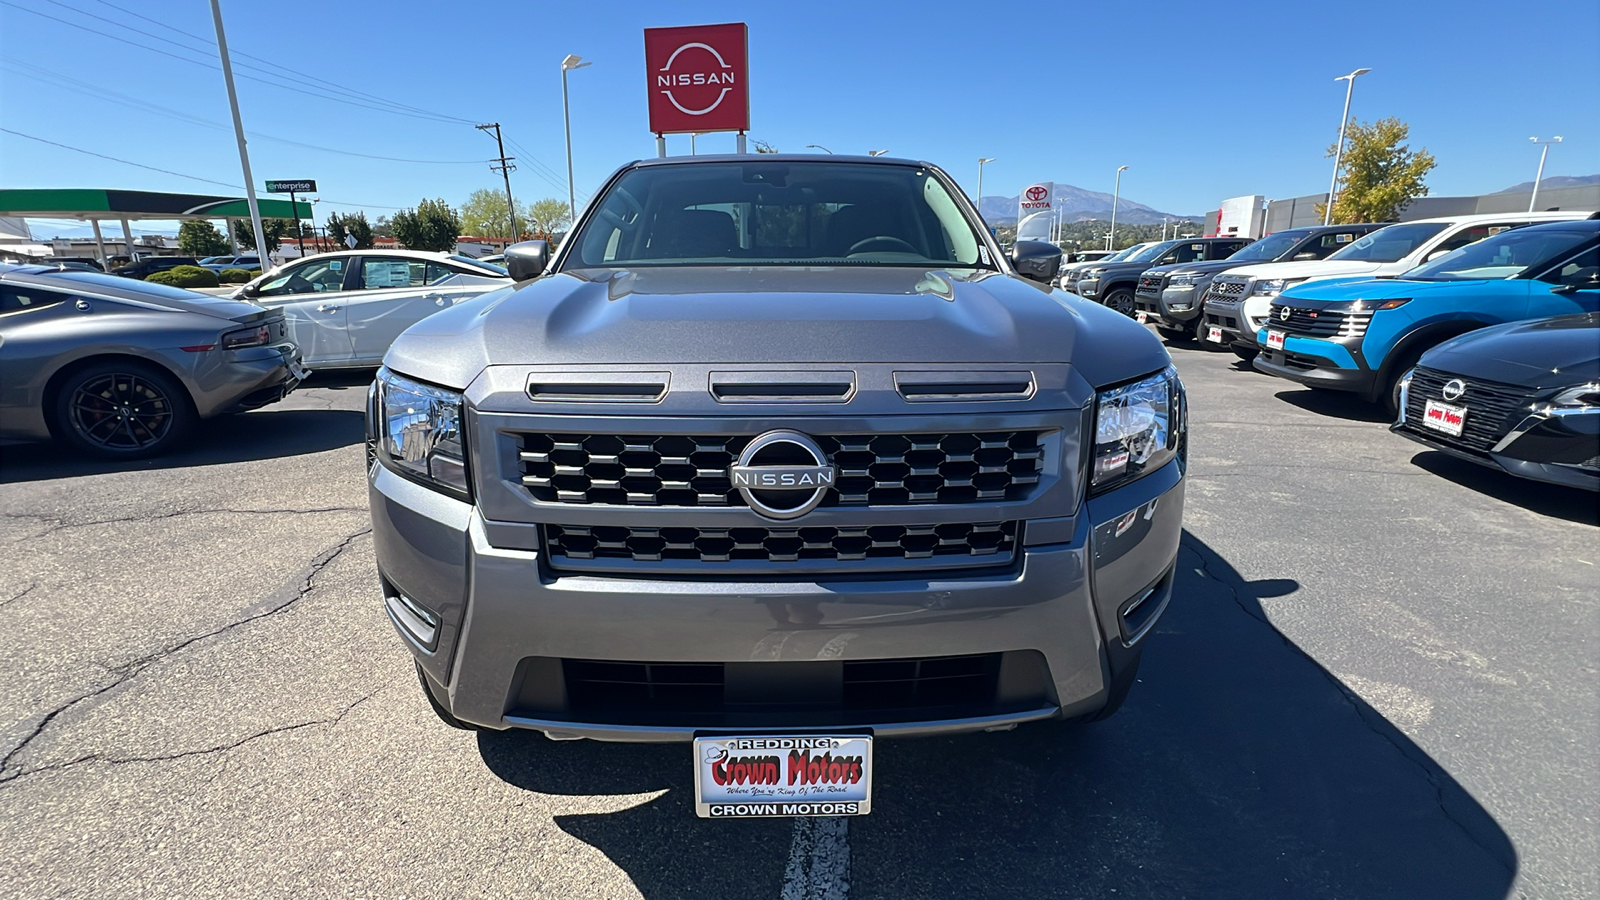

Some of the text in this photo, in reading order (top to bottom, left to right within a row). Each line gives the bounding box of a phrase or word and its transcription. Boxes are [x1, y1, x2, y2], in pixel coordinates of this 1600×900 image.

[658, 72, 734, 86] NISSAN
[268, 182, 310, 190] enterprise
[735, 472, 832, 486] NISSAN
[738, 740, 830, 750] REDDING
[711, 749, 863, 786] Crown Motors
[726, 785, 847, 797] Where You're King Of The Road
[710, 803, 858, 816] CROWN MOTORS
